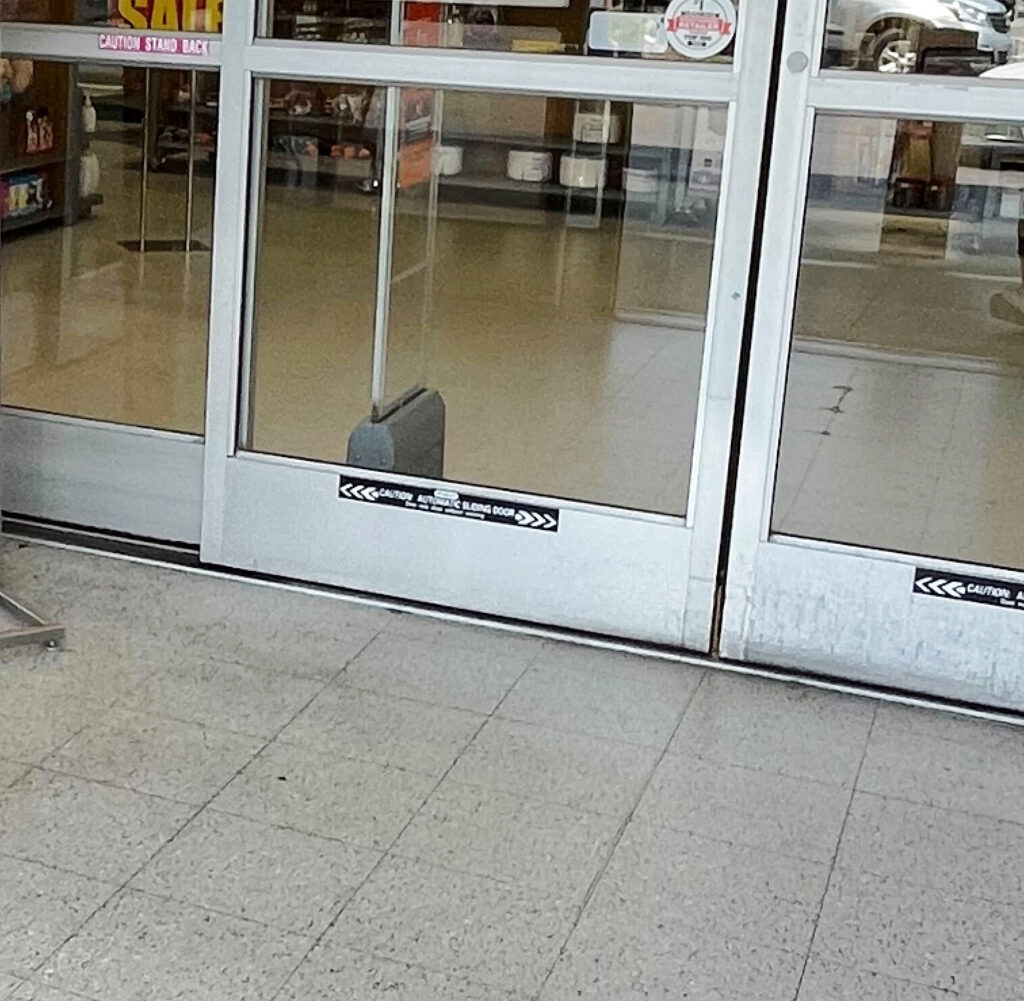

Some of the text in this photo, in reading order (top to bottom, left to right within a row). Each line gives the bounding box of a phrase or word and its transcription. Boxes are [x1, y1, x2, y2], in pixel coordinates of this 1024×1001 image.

[99, 34, 210, 55] CAUTION STAND BACK
[379, 487, 413, 500] CAUTION
[967, 583, 1011, 599] CAUTION
